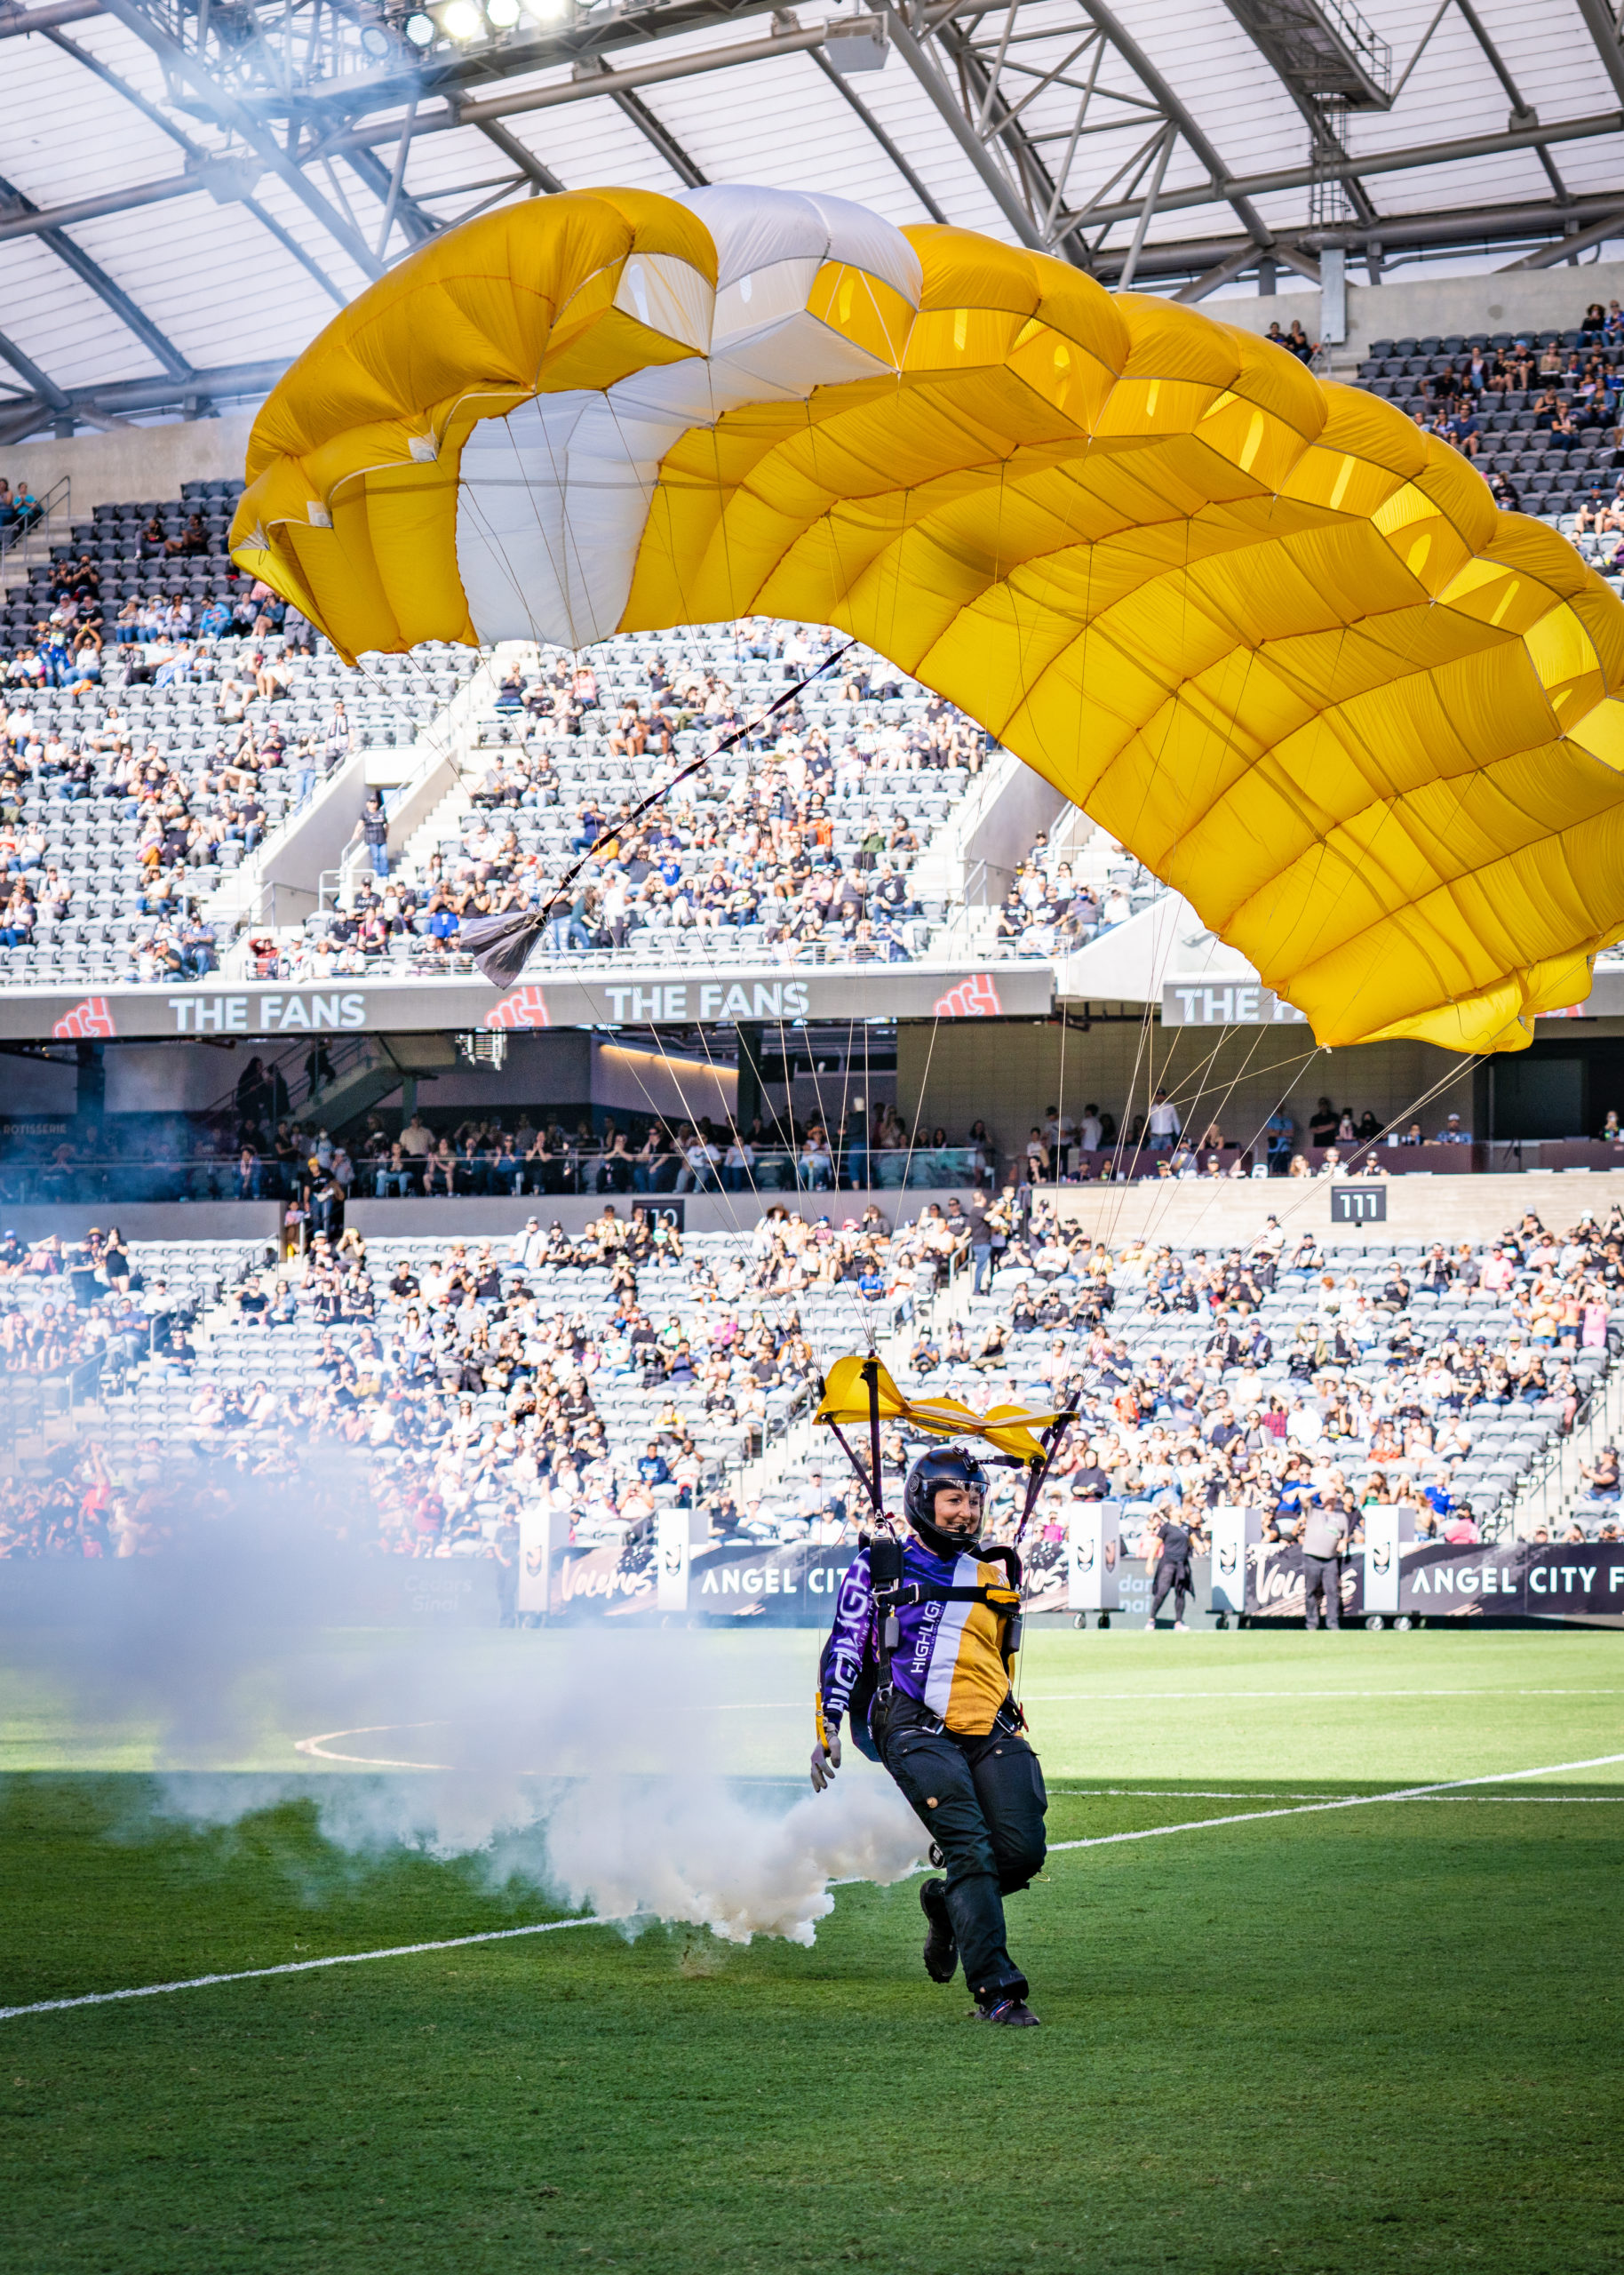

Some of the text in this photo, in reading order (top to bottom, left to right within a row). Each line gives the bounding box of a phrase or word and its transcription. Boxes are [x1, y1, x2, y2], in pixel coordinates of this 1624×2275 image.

[168, 994, 366, 1032] THE FANS
[604, 981, 809, 1021] THE FANS
[1174, 987, 1260, 1022] THE
[3, 1123, 67, 1135] ROTISSERIE
[1340, 1193, 1377, 1217] 111
[561, 1555, 655, 1600] Volemos
[701, 1568, 797, 1594] ANGEL
[1411, 1567, 1517, 1593] ANGEL
[1529, 1566, 1597, 1593] CITY
